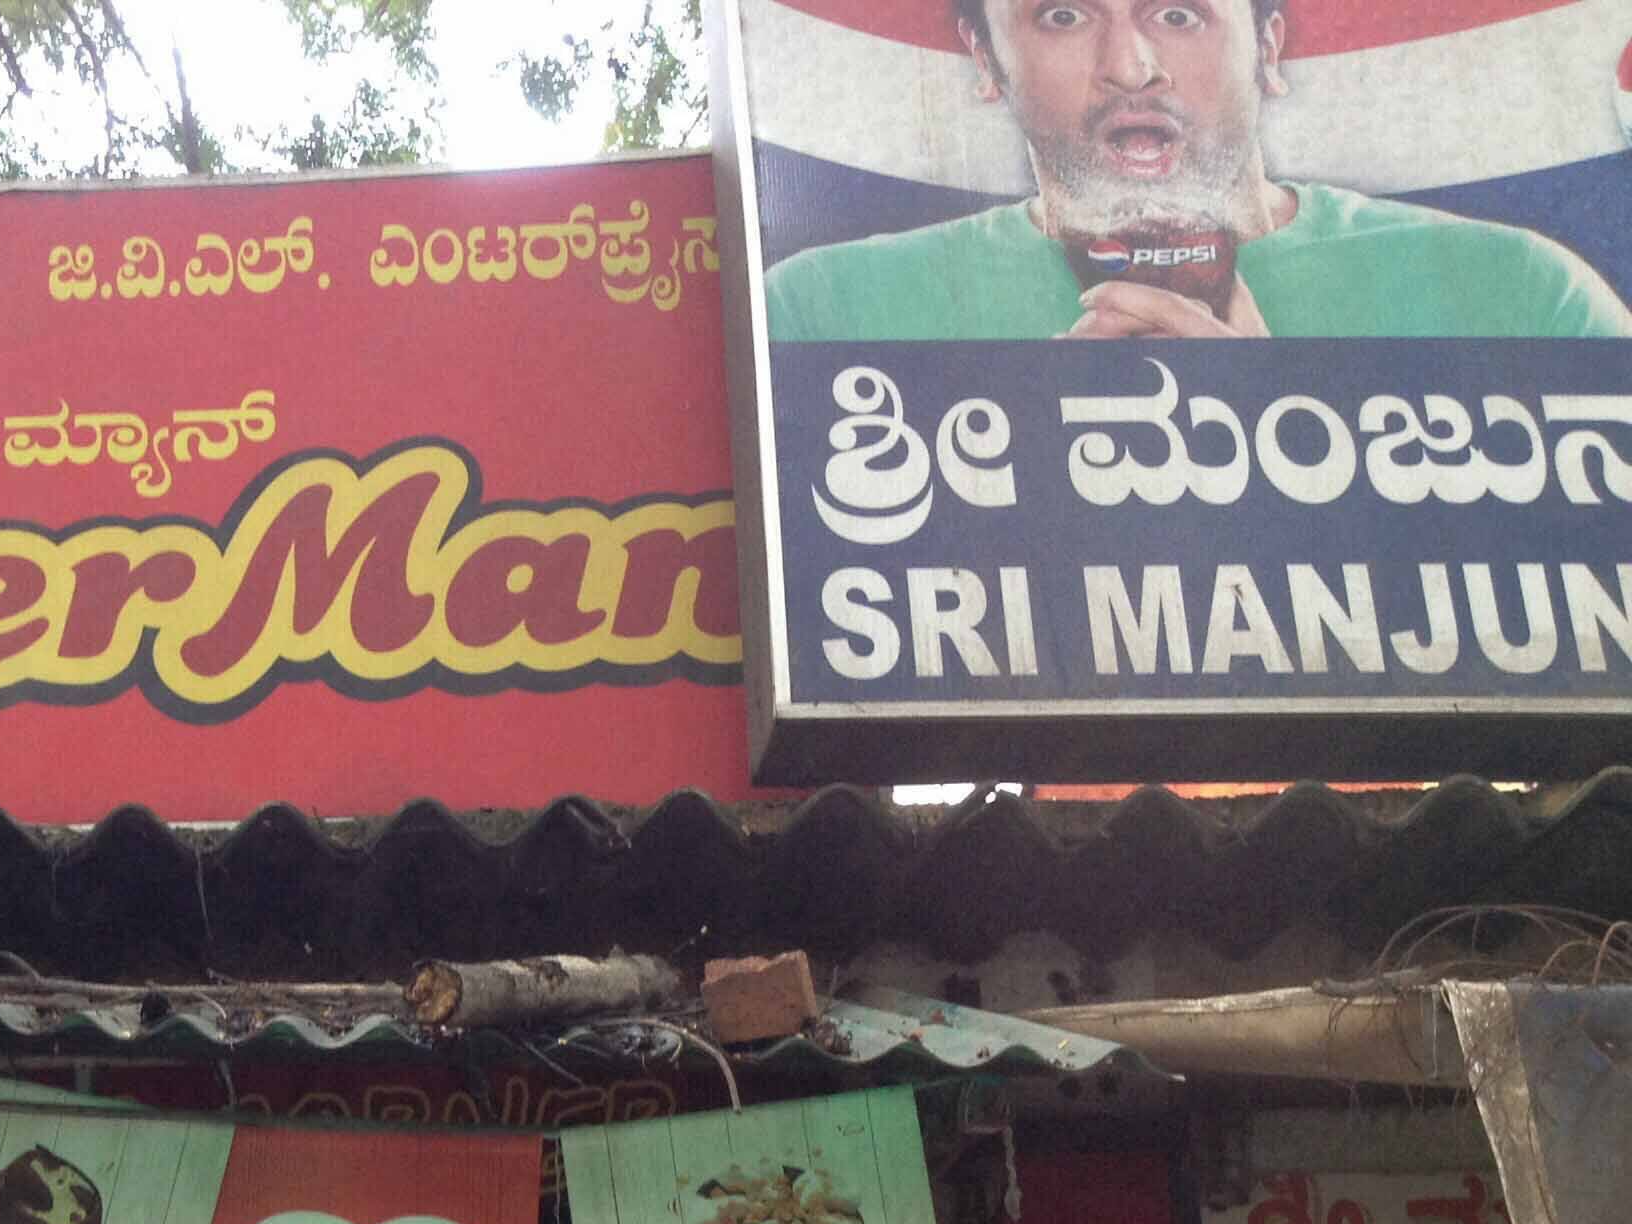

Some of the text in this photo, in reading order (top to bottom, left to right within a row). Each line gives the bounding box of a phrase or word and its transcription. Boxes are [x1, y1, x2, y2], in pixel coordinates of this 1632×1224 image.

[1132, 244, 1217, 266] PEPSI
[4, 389, 276, 498] ಮ್ಯಾನ್
[812, 356, 1632, 545] ಶ್ರೀ ಮಂಜುನ
[821, 561, 1632, 681] SRI MANJUN
